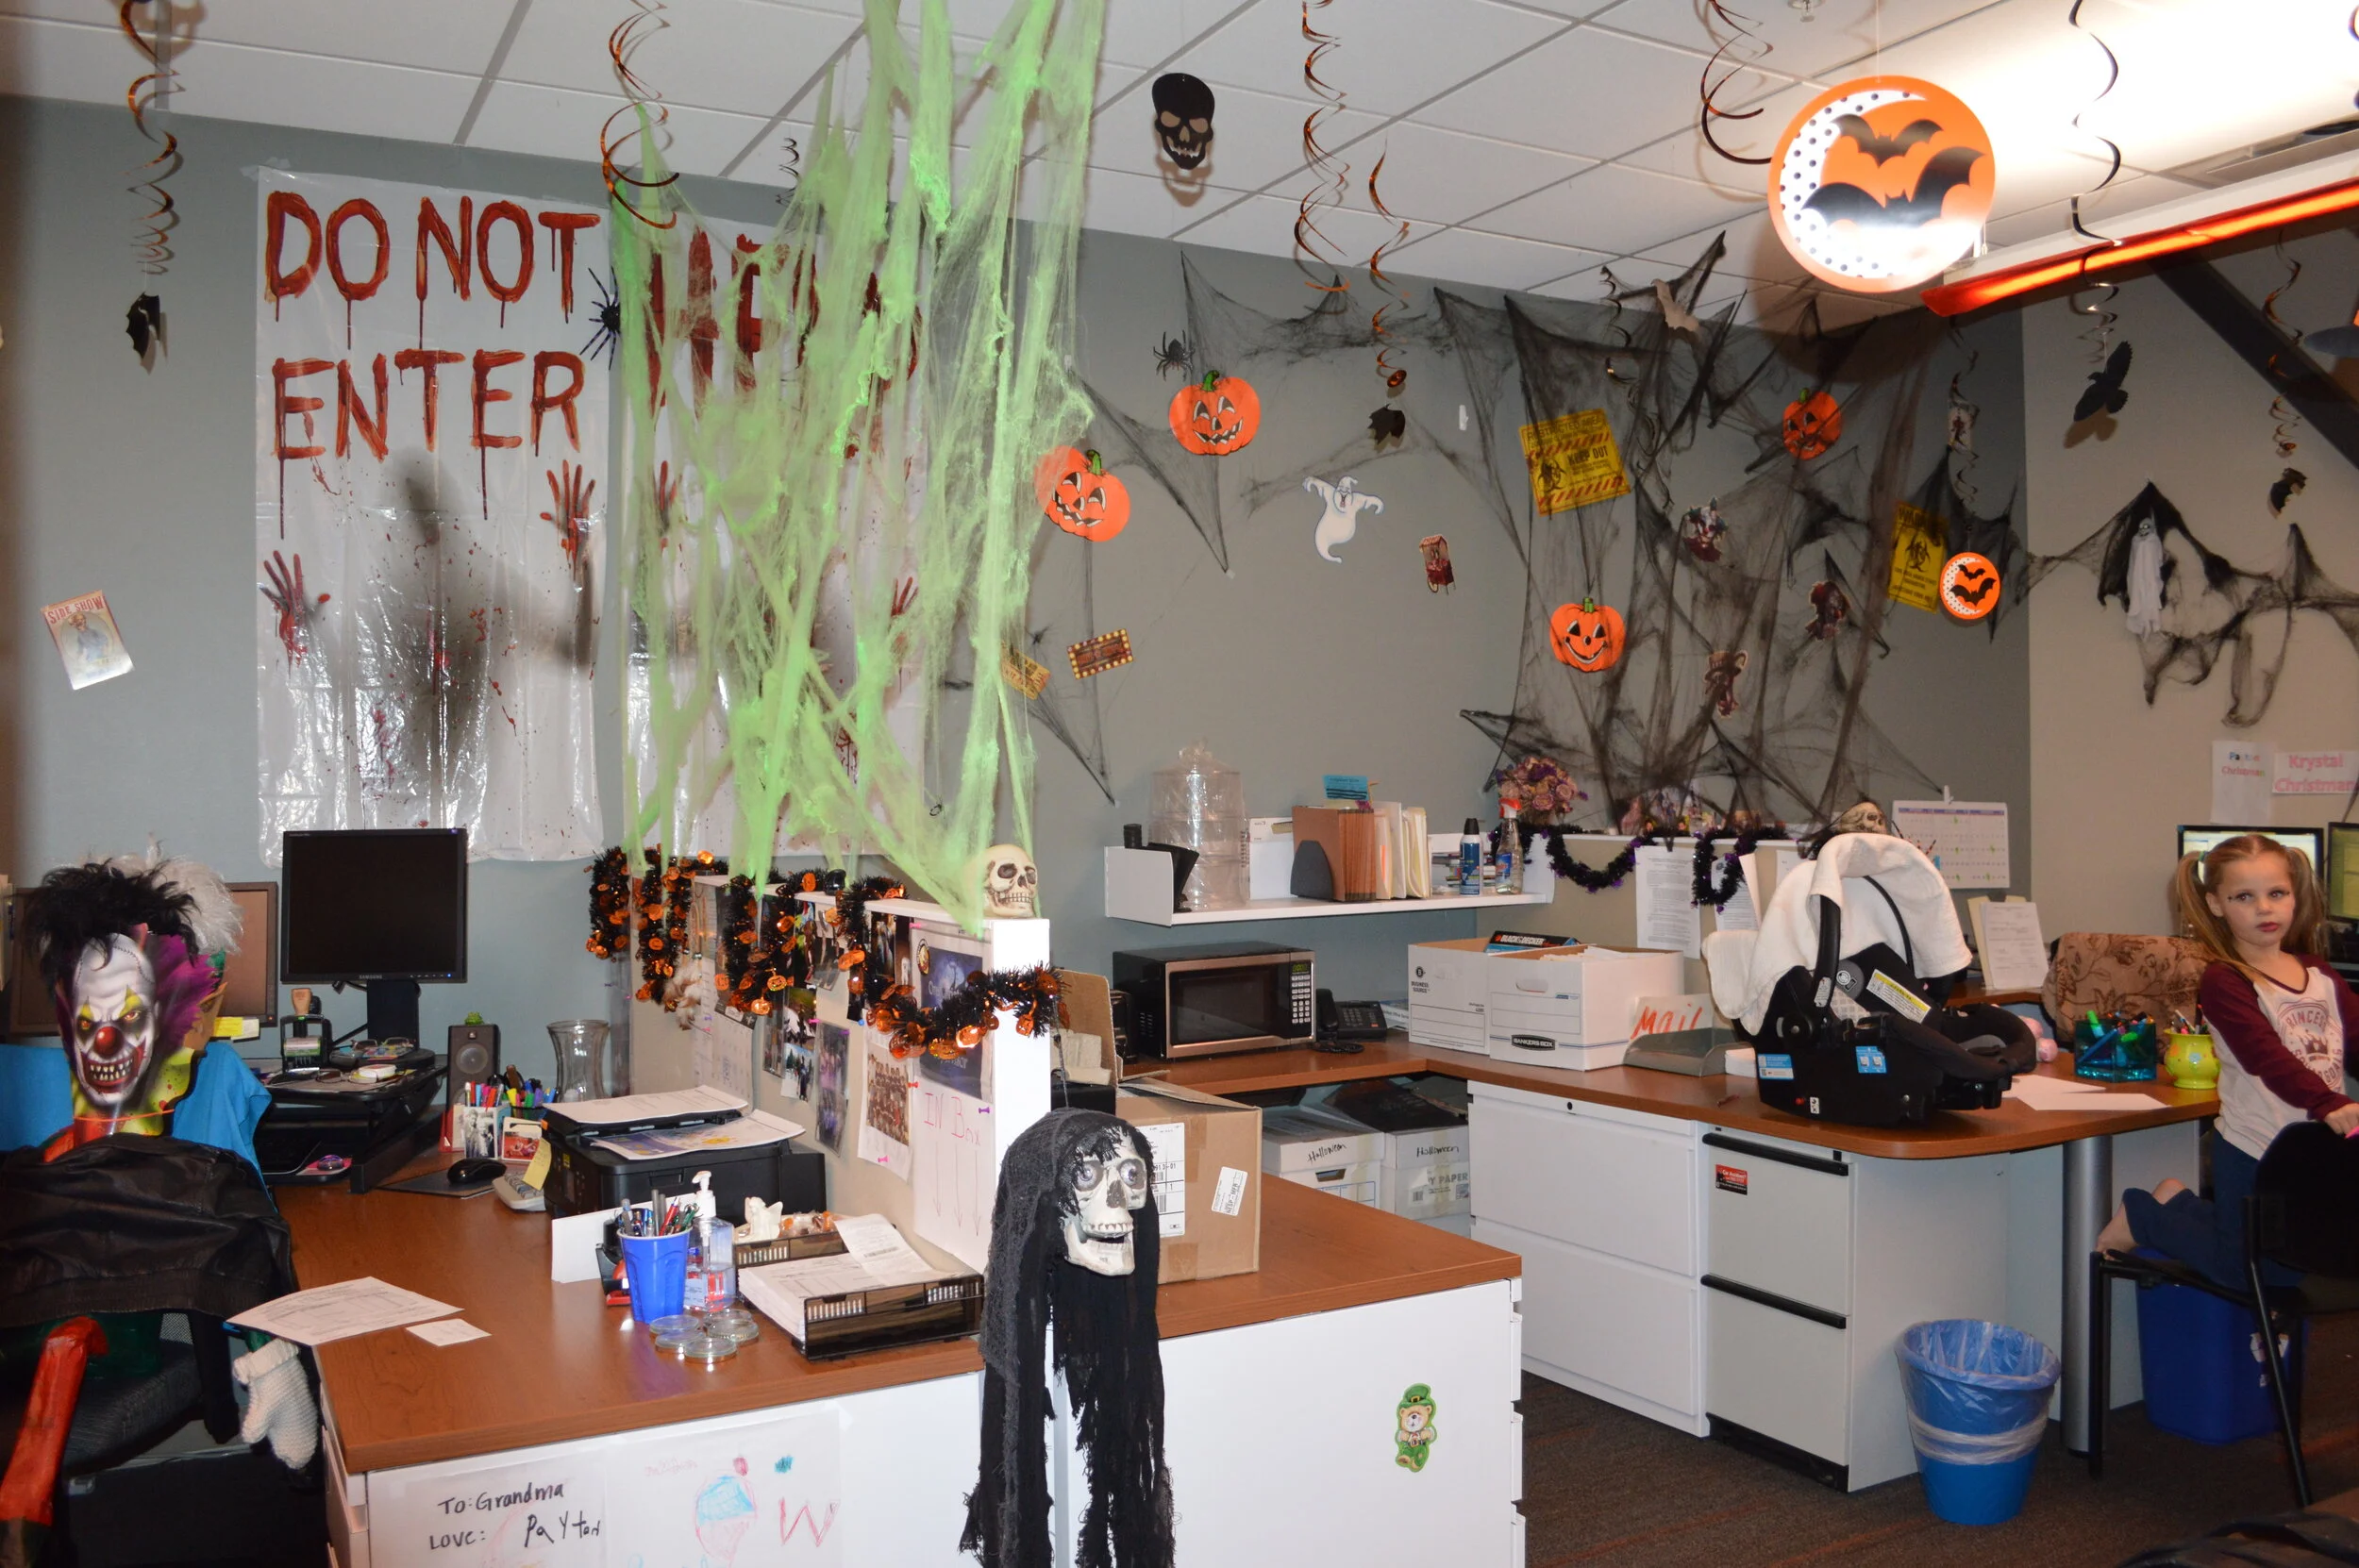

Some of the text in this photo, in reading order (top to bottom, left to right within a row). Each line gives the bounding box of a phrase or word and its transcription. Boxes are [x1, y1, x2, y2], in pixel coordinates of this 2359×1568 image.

[265, 191, 601, 326] DO NOT
[271, 349, 585, 483] ENTER
[1593, 445, 1609, 459] OUT
[47, 595, 105, 625] SIDE SHOW
[2288, 754, 2344, 771] Krystal
[1630, 1003, 1703, 1040] Mail
[924, 1093, 945, 1129] IN
[1416, 1144, 1460, 1159] Halloween
[1438, 1172, 1468, 1184] PAPER
[476, 1482, 564, 1511] Grandma
